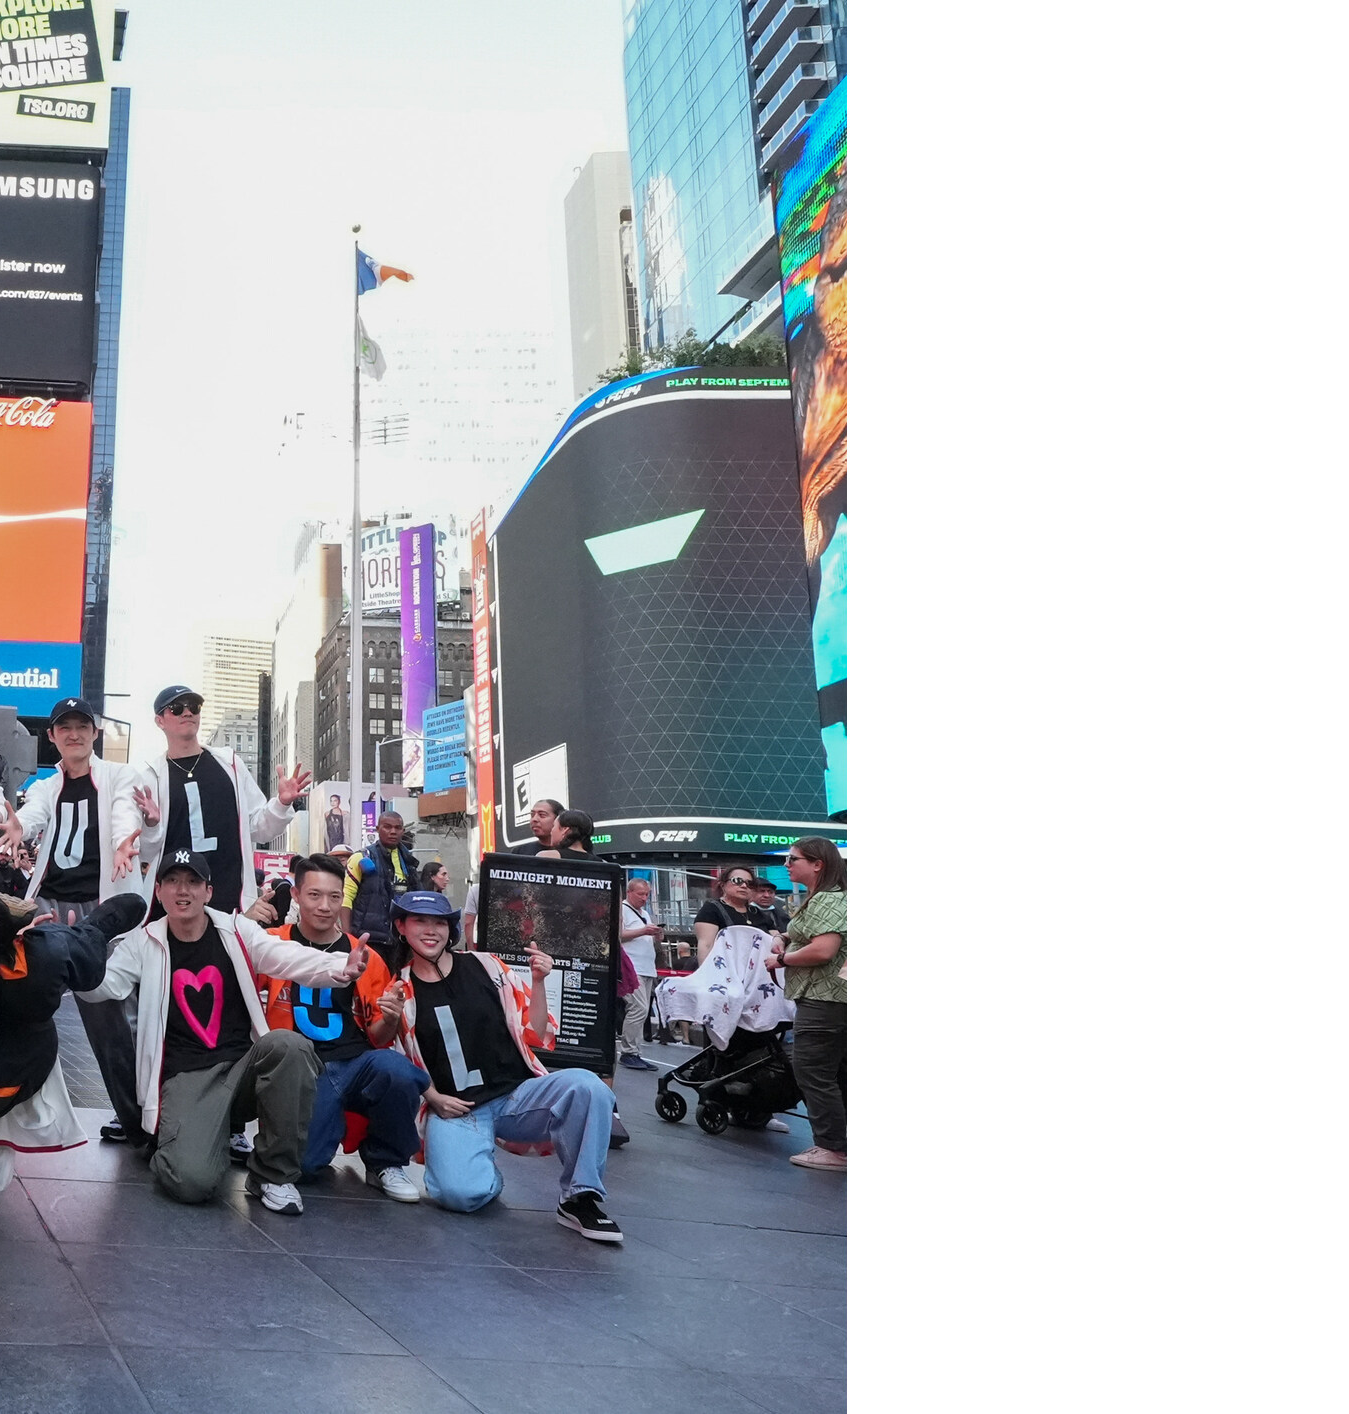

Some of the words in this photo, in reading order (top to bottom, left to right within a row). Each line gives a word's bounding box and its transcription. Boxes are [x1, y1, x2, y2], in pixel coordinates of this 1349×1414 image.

[13, 33, 89, 63] TIMES
[23, 97, 88, 119] TSQ.ORG
[33, 262, 66, 274] now
[666, 378, 699, 388] PLAY
[701, 378, 737, 386] FROM
[361, 526, 404, 553] ITTLE
[474, 626, 489, 687] COME
[477, 686, 491, 763] INSIDE!
[183, 781, 219, 853] L
[53, 798, 90, 870] U
[655, 830, 699, 842] FC24
[724, 833, 758, 843] PLAY
[761, 834, 800, 845] FROM
[174, 850, 191, 864] NY
[489, 868, 555, 885] MIDNIGHT
[556, 875, 612, 891] MOMENT
[433, 1004, 485, 1092] L
